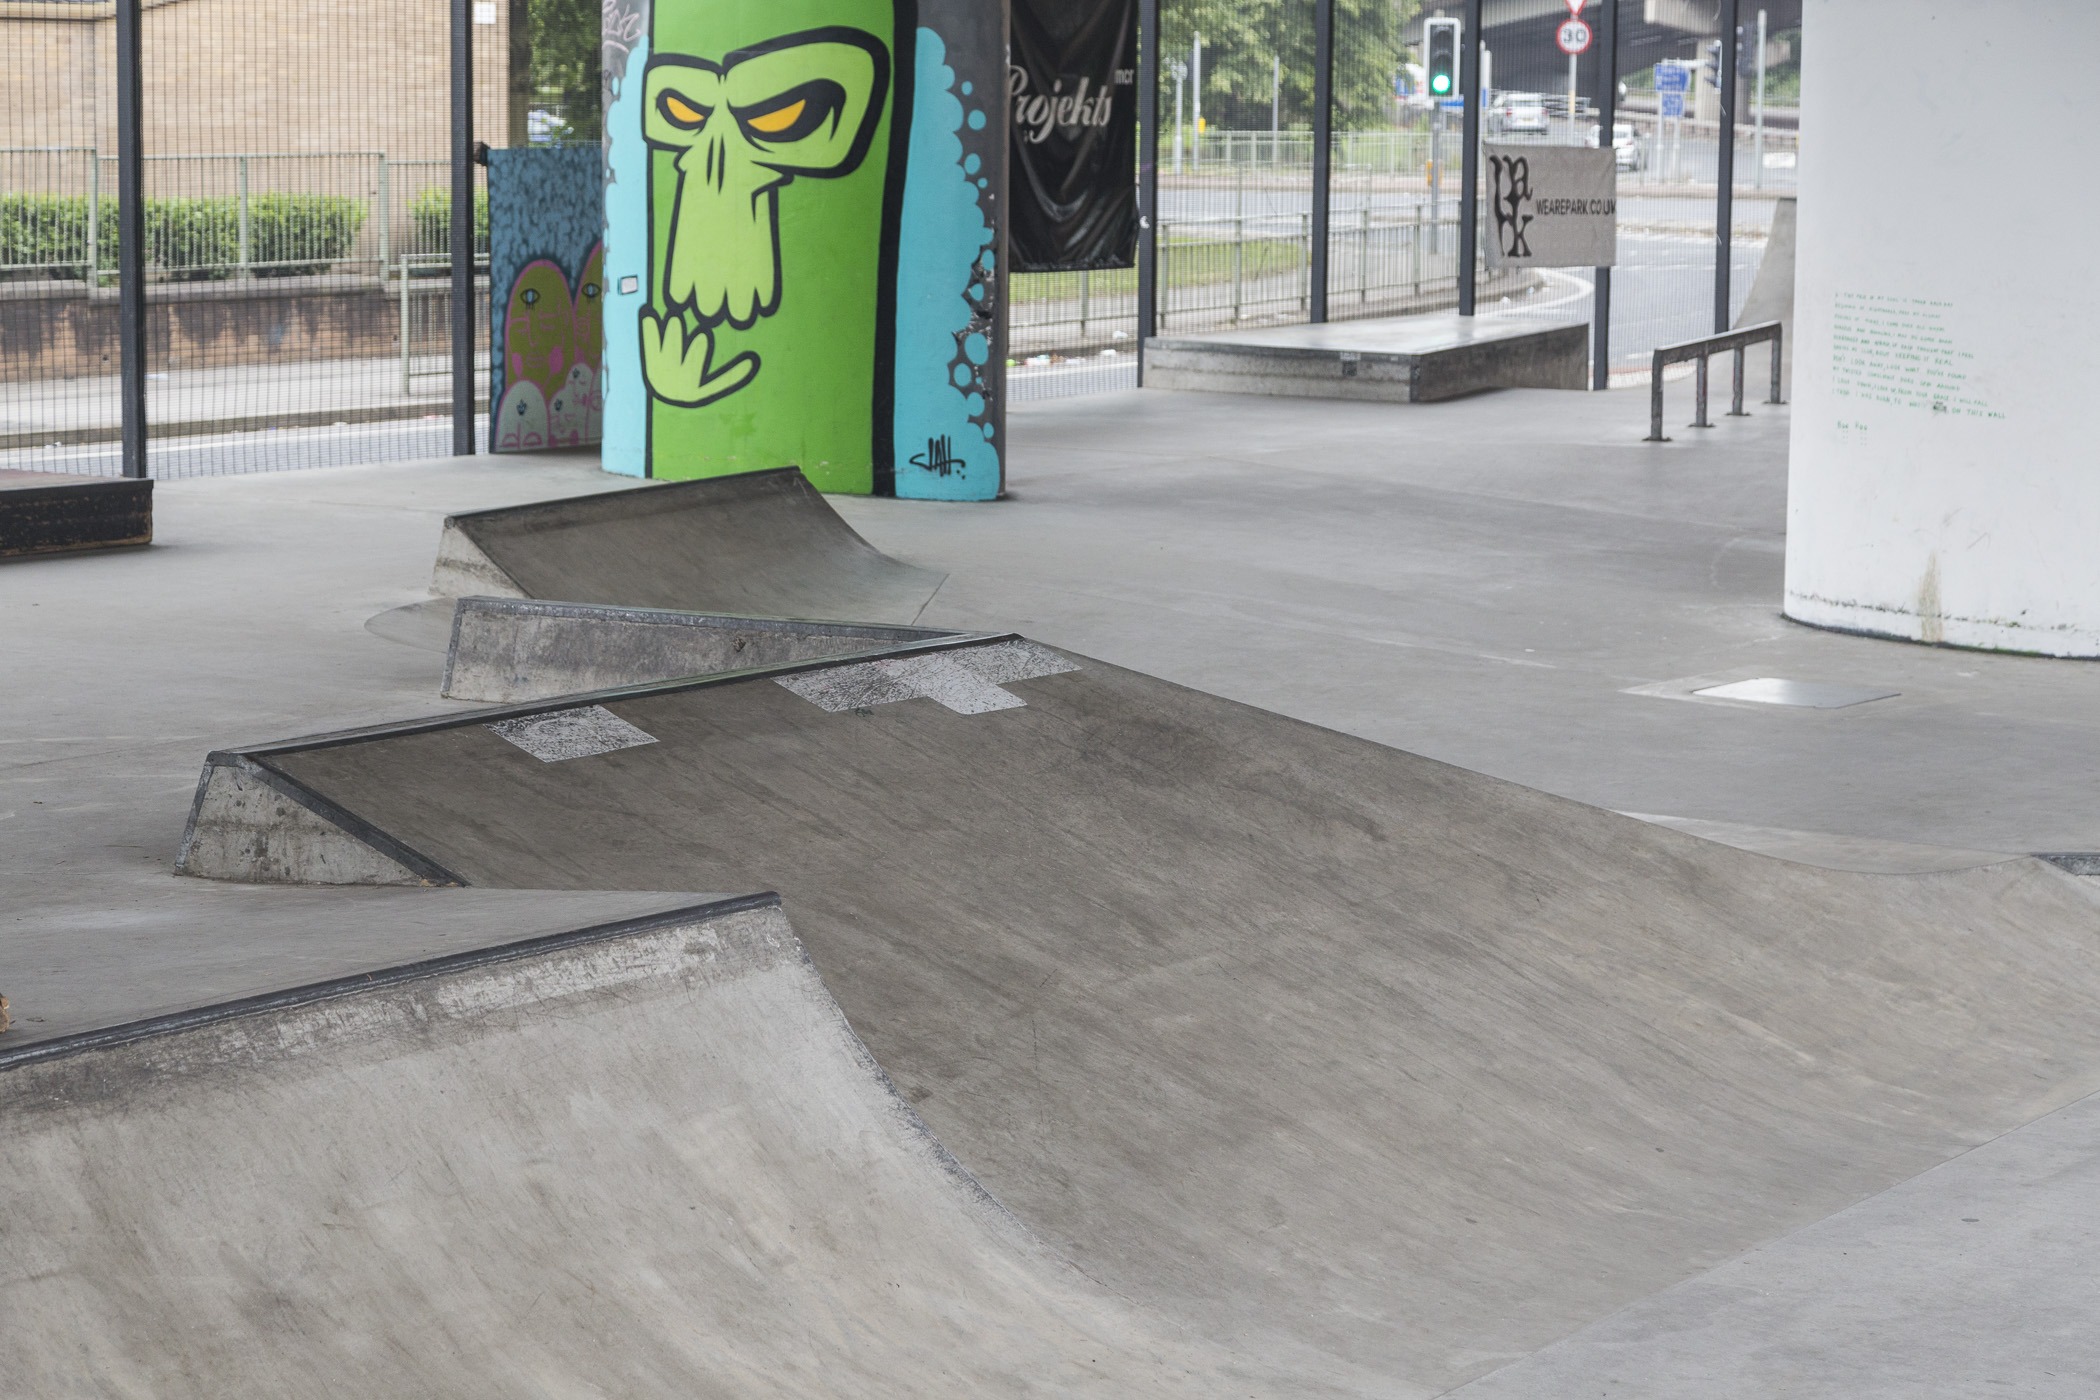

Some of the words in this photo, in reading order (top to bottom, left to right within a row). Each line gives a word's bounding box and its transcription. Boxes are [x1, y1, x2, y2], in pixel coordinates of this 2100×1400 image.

[1563, 28, 1587, 43] 30
[1115, 69, 1134, 84] mcr
[1010, 65, 1112, 143] Projekts
